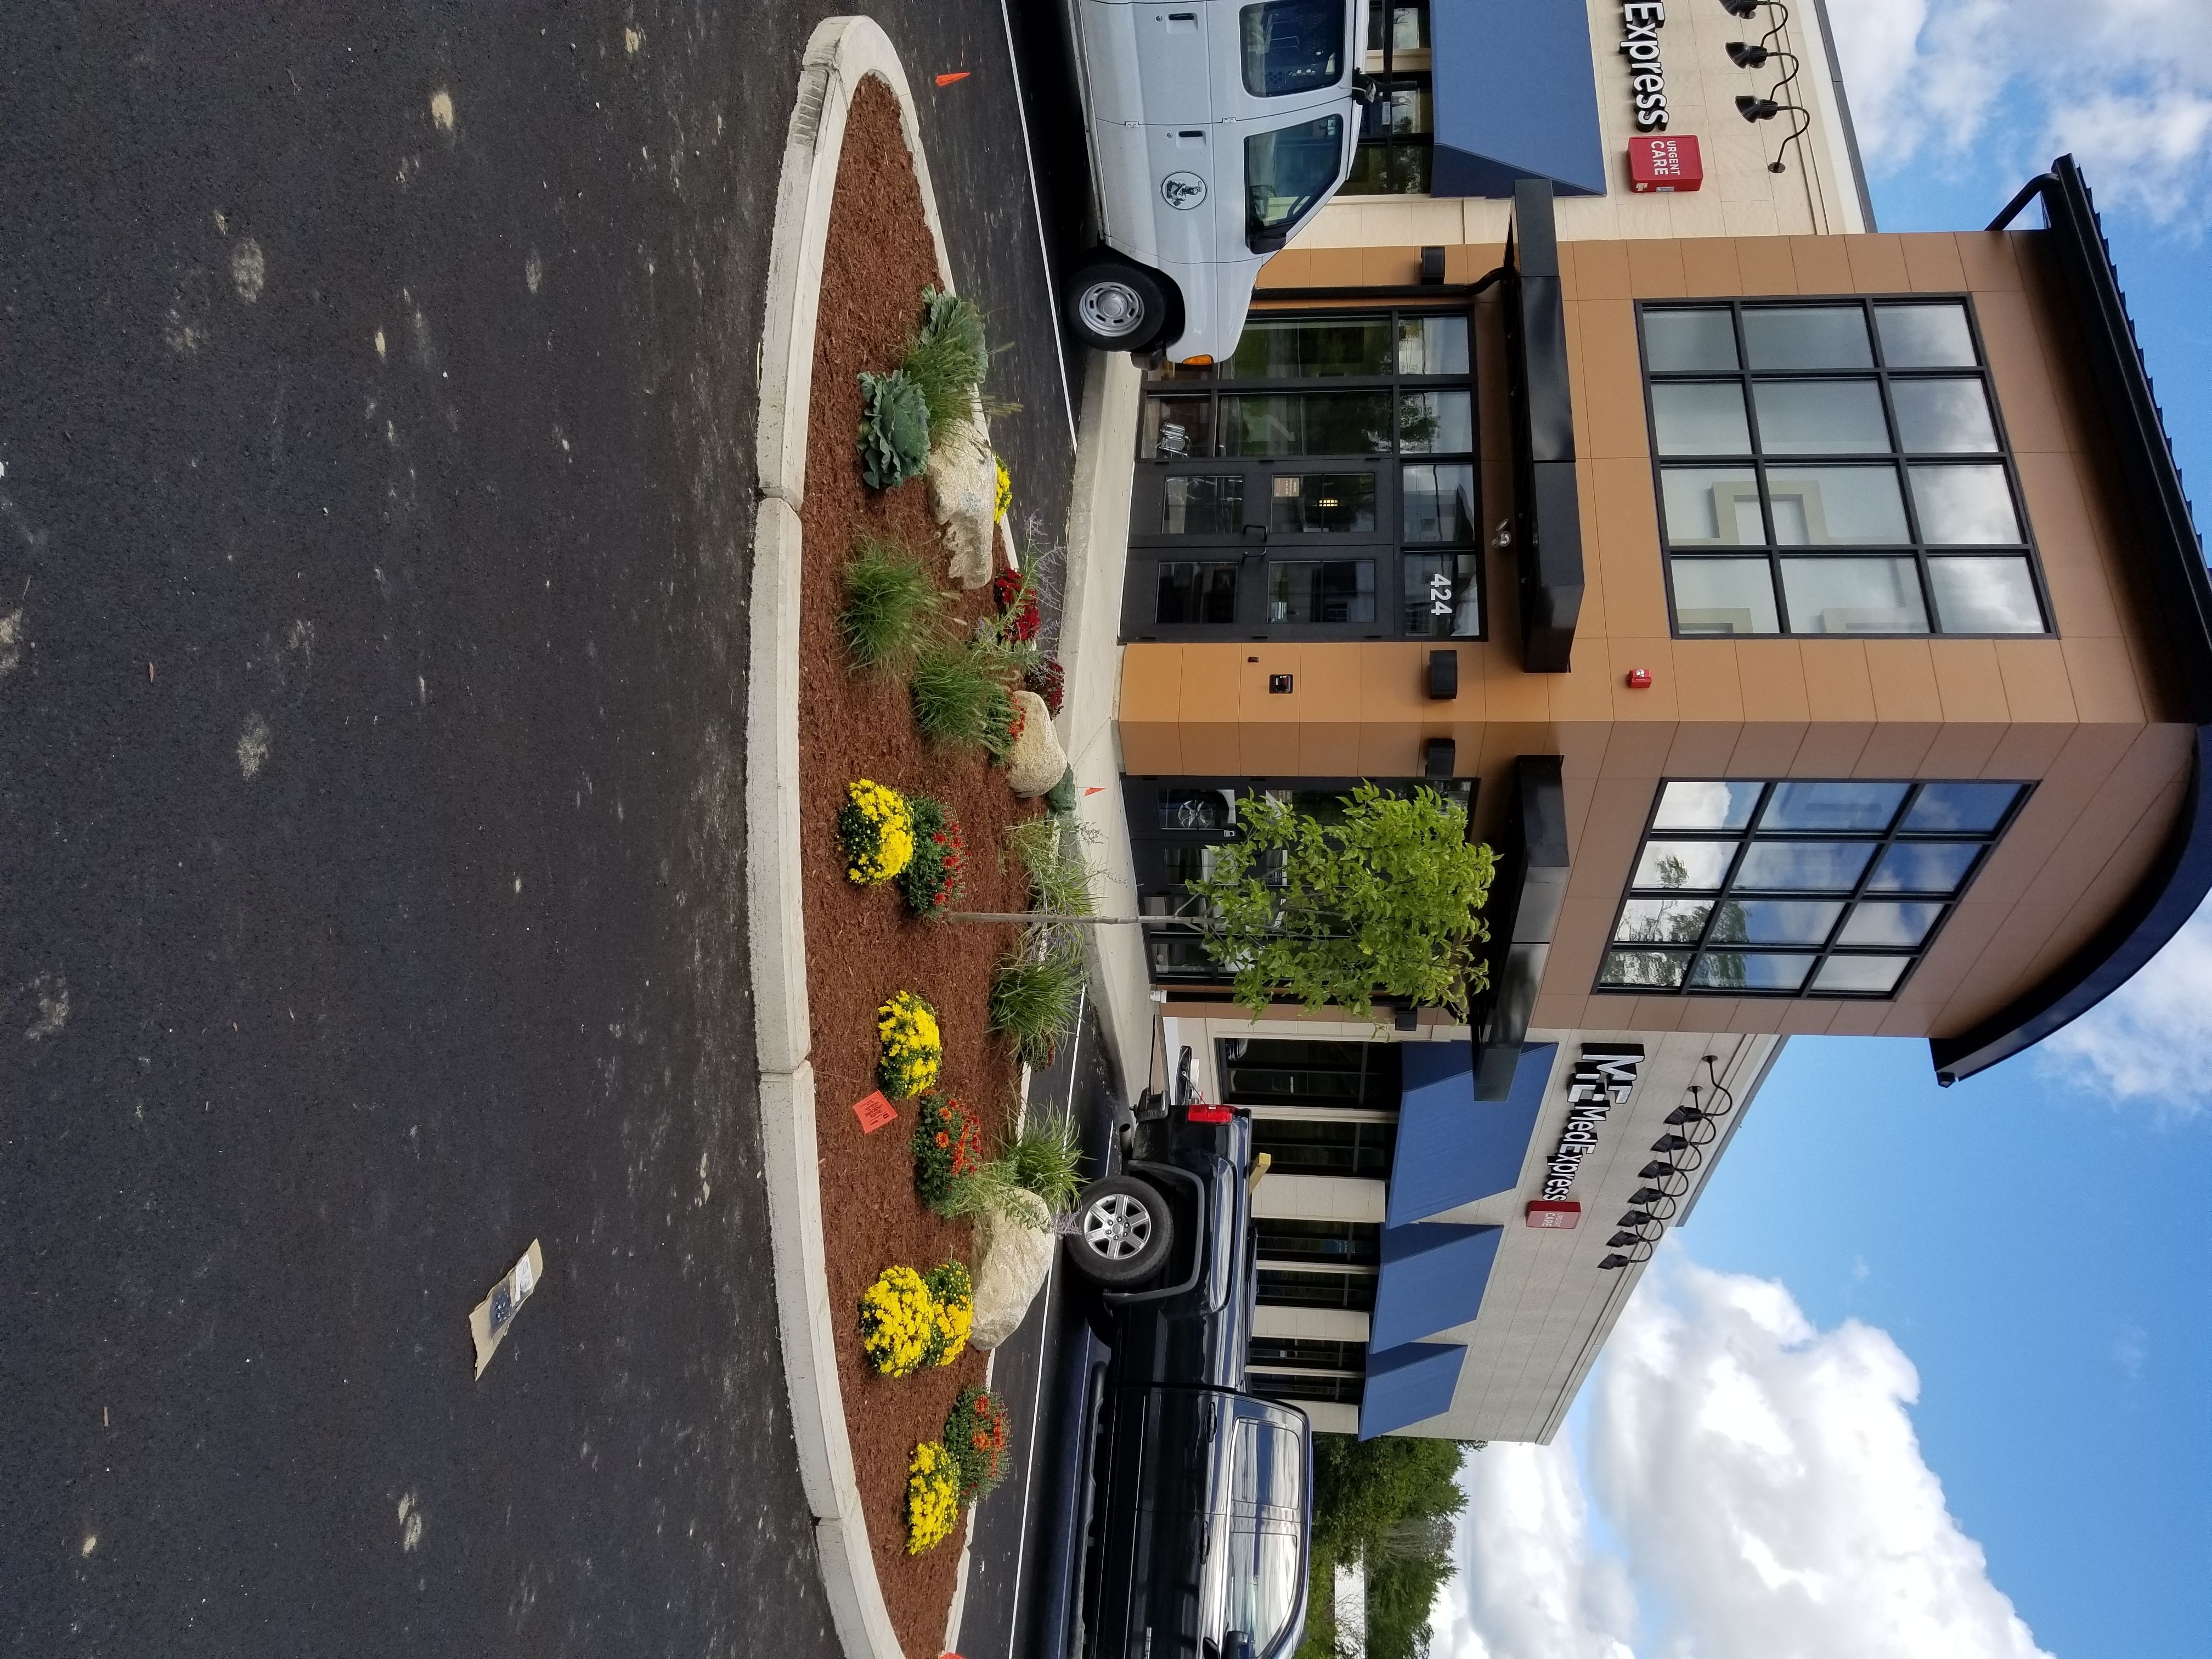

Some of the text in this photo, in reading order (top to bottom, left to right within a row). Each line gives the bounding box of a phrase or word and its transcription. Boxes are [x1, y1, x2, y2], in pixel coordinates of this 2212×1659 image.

[1620, 2, 1669, 126] Express
[1651, 140, 1668, 176] CARE
[1666, 140, 1680, 176] URGENT
[1430, 573, 1452, 616] 424
[1542, 1105, 1611, 1201] MedExpress
[1542, 1212, 1555, 1227] CARE
[1553, 1213, 1564, 1227] URGENT
